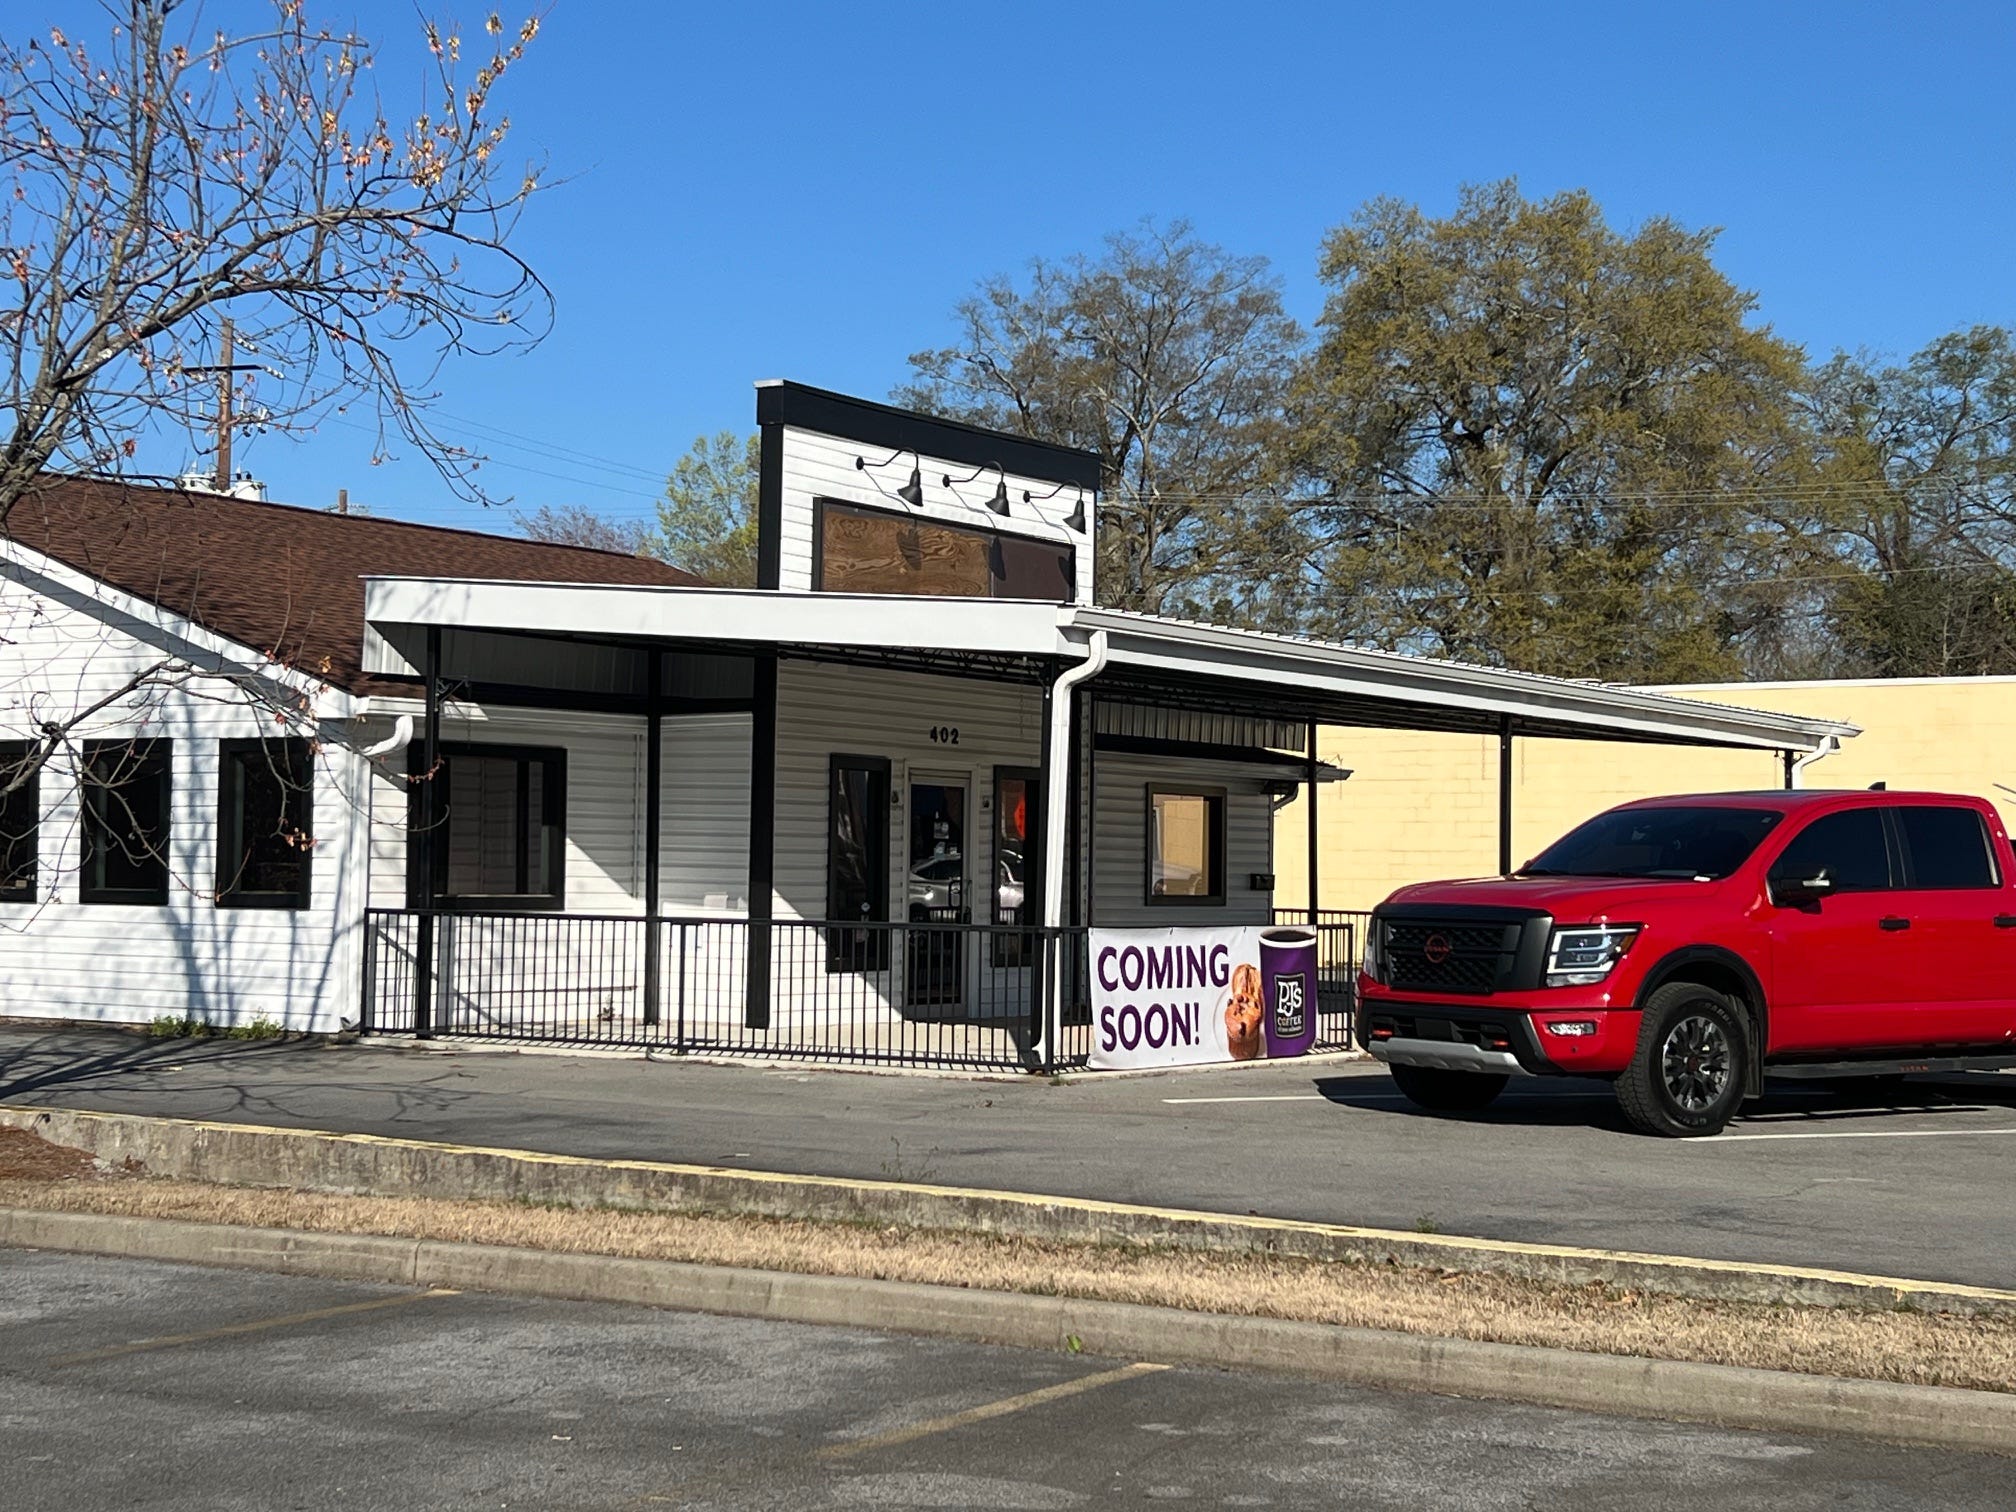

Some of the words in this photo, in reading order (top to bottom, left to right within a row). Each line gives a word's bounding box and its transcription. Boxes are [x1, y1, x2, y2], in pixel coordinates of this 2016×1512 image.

[929, 726, 959, 745] 402
[1097, 943, 1230, 992] COMING
[1101, 1002, 1200, 1052] SOON!
